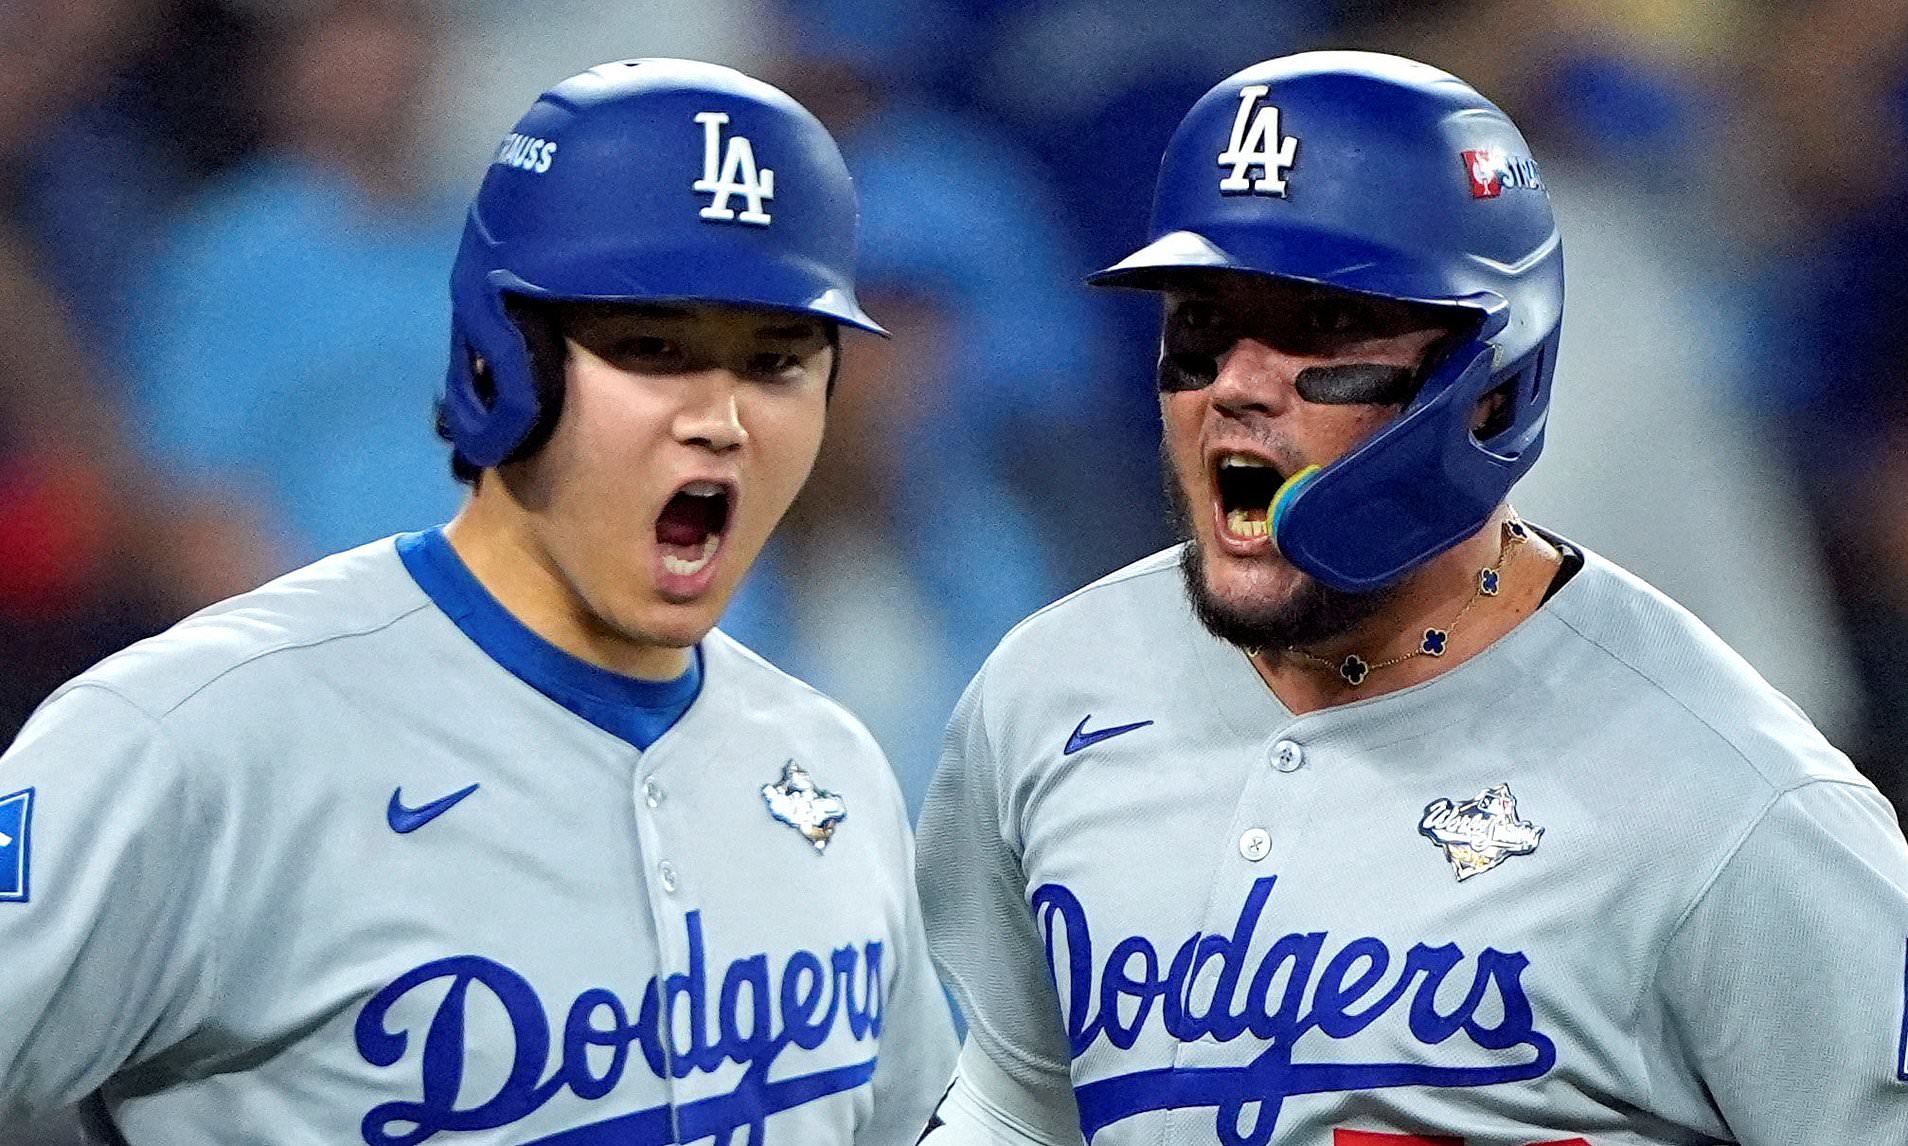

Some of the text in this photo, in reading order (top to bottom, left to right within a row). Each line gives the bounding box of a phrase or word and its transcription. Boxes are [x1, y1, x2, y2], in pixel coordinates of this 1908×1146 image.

[693, 111, 774, 225] LA
[1217, 85, 1298, 197] LA
[1031, 875, 1557, 1146] Dodgers
